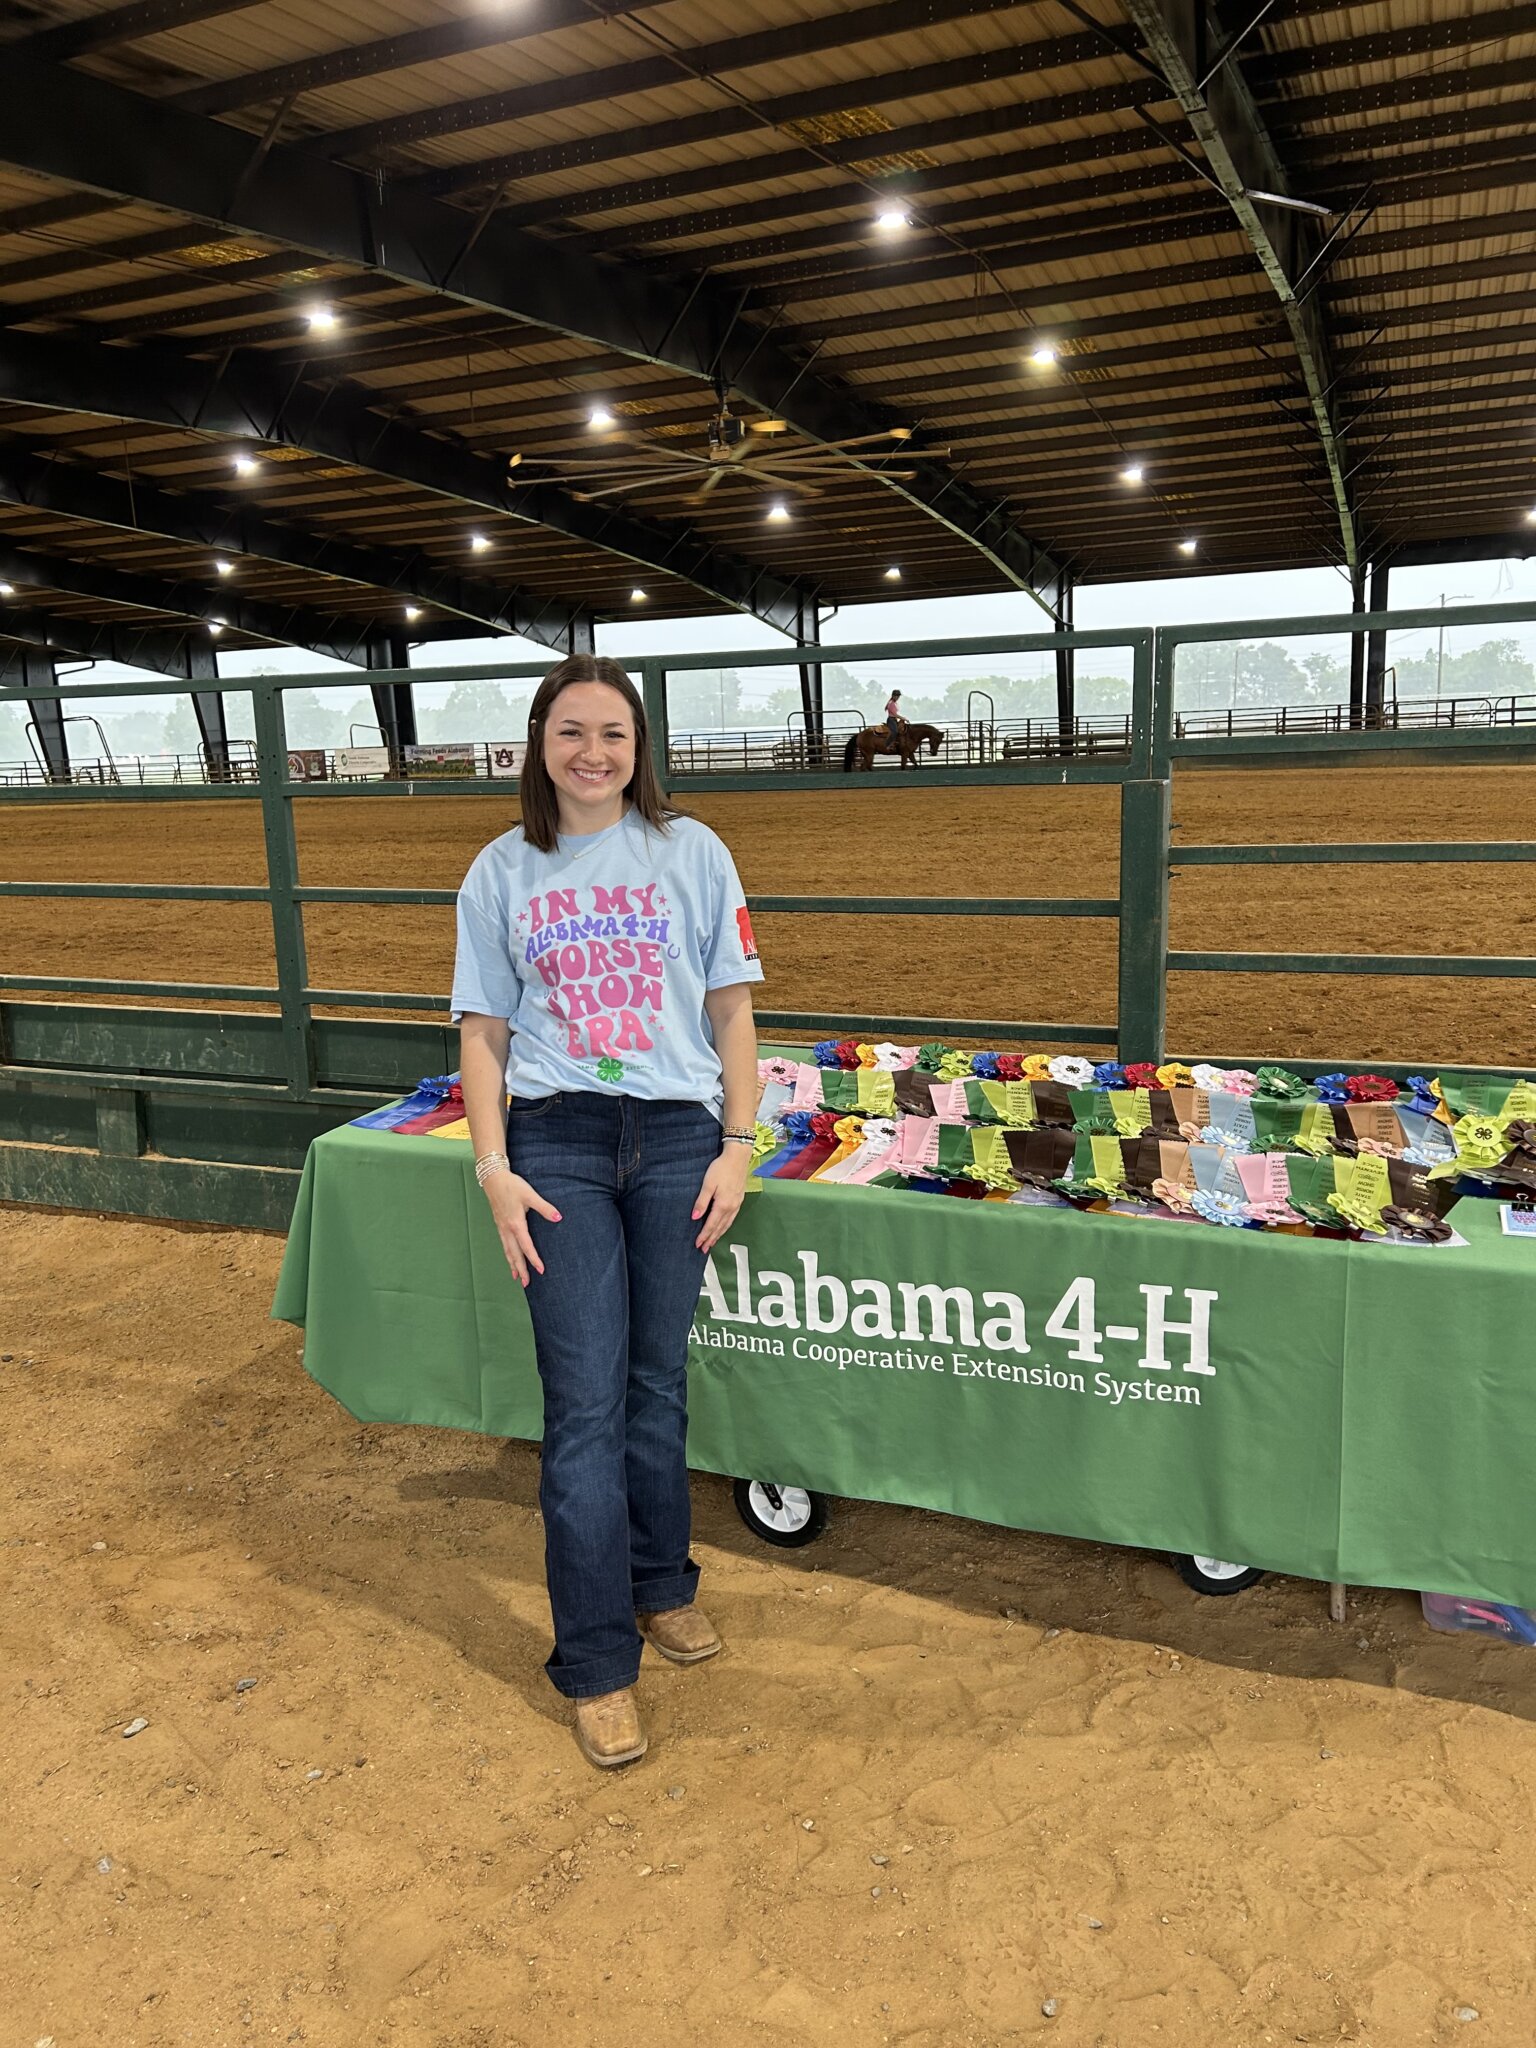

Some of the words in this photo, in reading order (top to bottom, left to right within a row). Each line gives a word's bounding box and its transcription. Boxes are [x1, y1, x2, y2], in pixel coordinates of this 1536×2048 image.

[529, 888, 581, 934] IN
[591, 882, 656, 917] MY
[525, 914, 620, 964] ALABAMA
[534, 938, 663, 988] HORSE
[547, 974, 663, 1021] SHOW
[566, 1009, 654, 1059] ERA
[697, 1244, 1031, 1354] Alabama
[1045, 1276, 1218, 1376] 4-H
[688, 1324, 785, 1356] Alabama
[792, 1337, 945, 1372] Cooperative
[952, 1353, 1085, 1392] Extension
[1094, 1372, 1201, 1406] System
